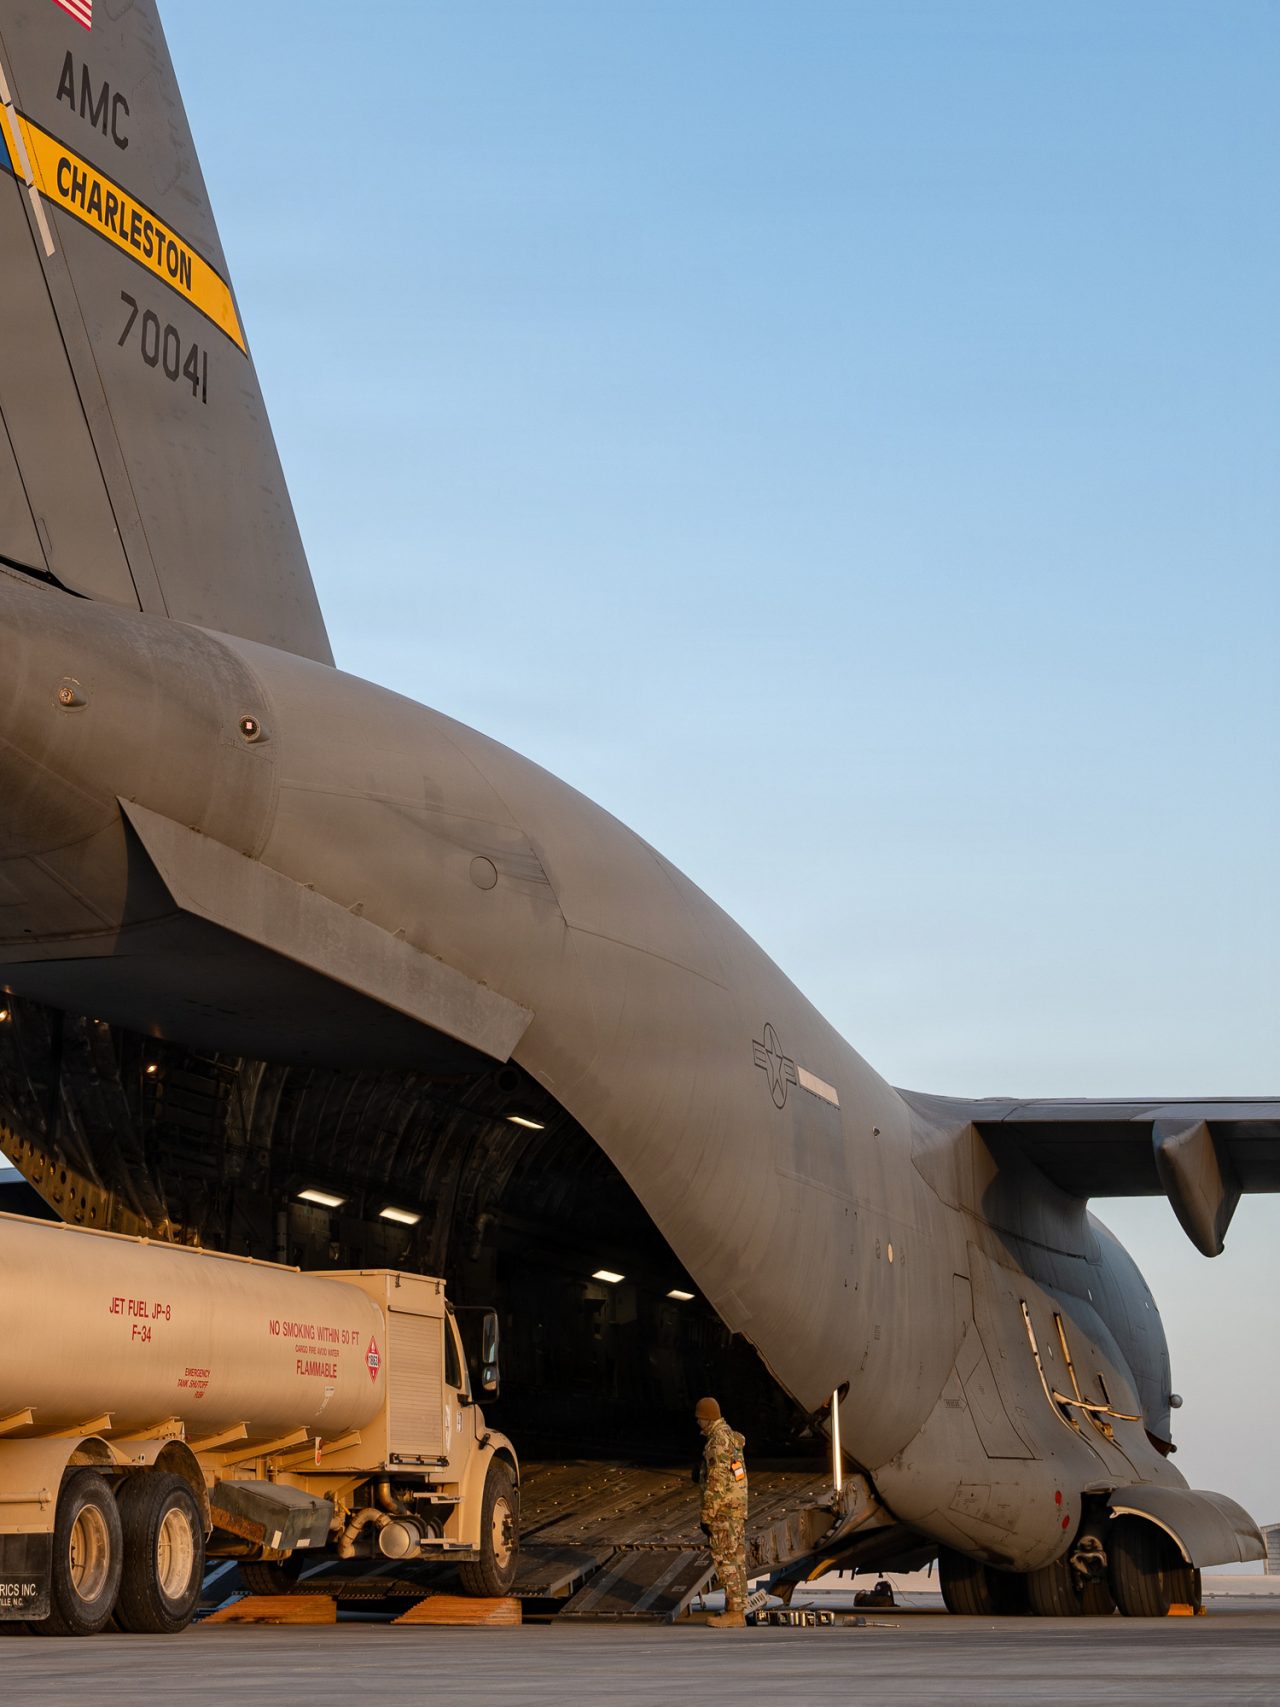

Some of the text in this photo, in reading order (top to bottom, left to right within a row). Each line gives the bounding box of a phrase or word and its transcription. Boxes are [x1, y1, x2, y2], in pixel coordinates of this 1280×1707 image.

[56, 49, 130, 150] AMC
[56, 156, 193, 291] CHARLESTON
[117, 290, 208, 404] 70041
[109, 1297, 171, 1321] JET FUEL JP-8
[131, 1324, 152, 1343] F-34
[269, 1320, 360, 1346] NO SMOKING WITHIN 50 FT
[296, 1360, 338, 1379] FLAMMABLE
[21, 1583, 39, 1597] INC.
